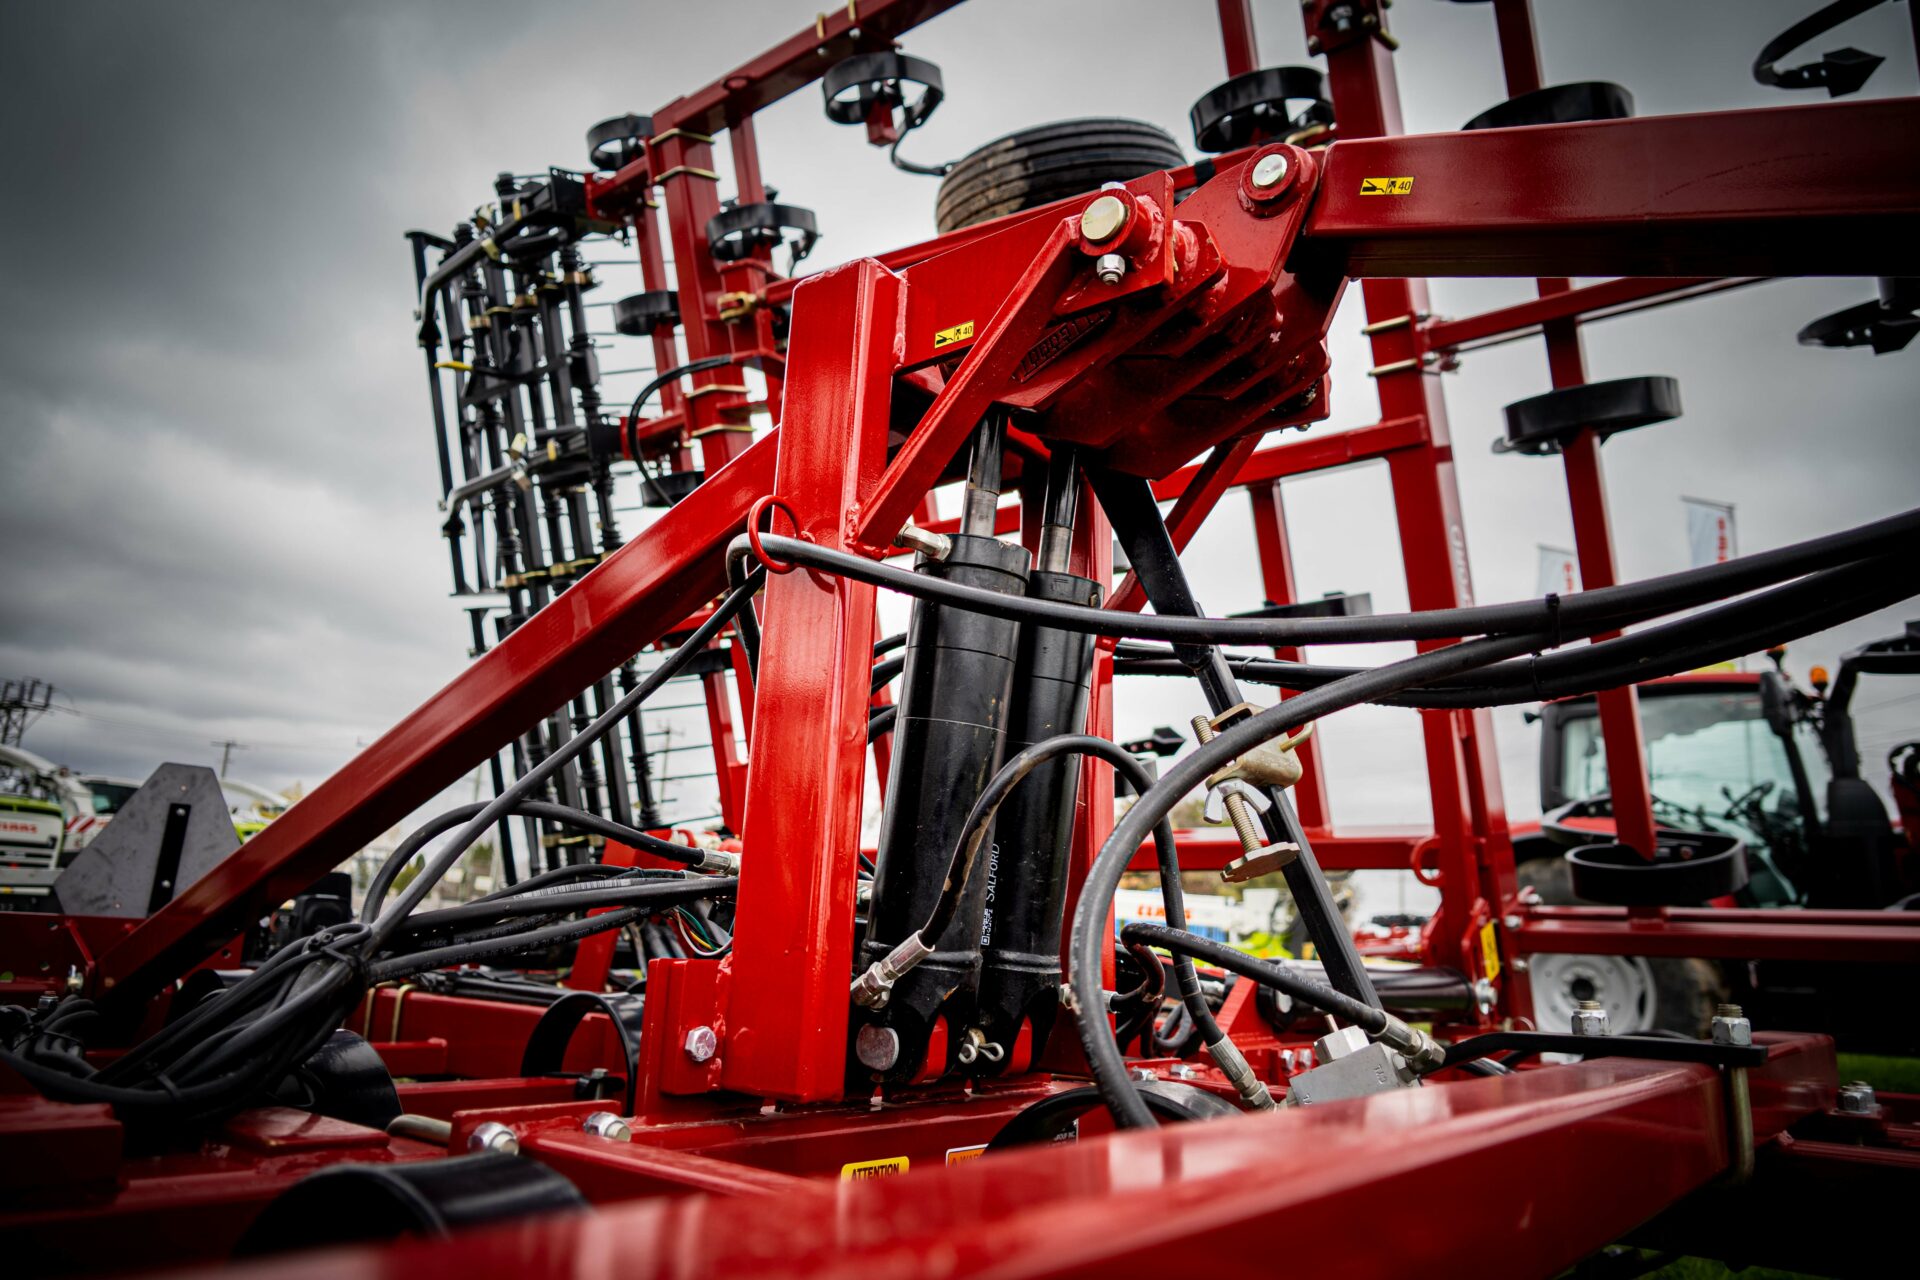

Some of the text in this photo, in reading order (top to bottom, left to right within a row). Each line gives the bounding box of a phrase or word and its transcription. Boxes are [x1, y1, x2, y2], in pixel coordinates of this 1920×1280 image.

[1398, 180, 1411, 191] 40
[962, 325, 973, 335] 40
[986, 843, 1000, 902] SALFORD
[852, 1163, 899, 1180] ATTENTION
